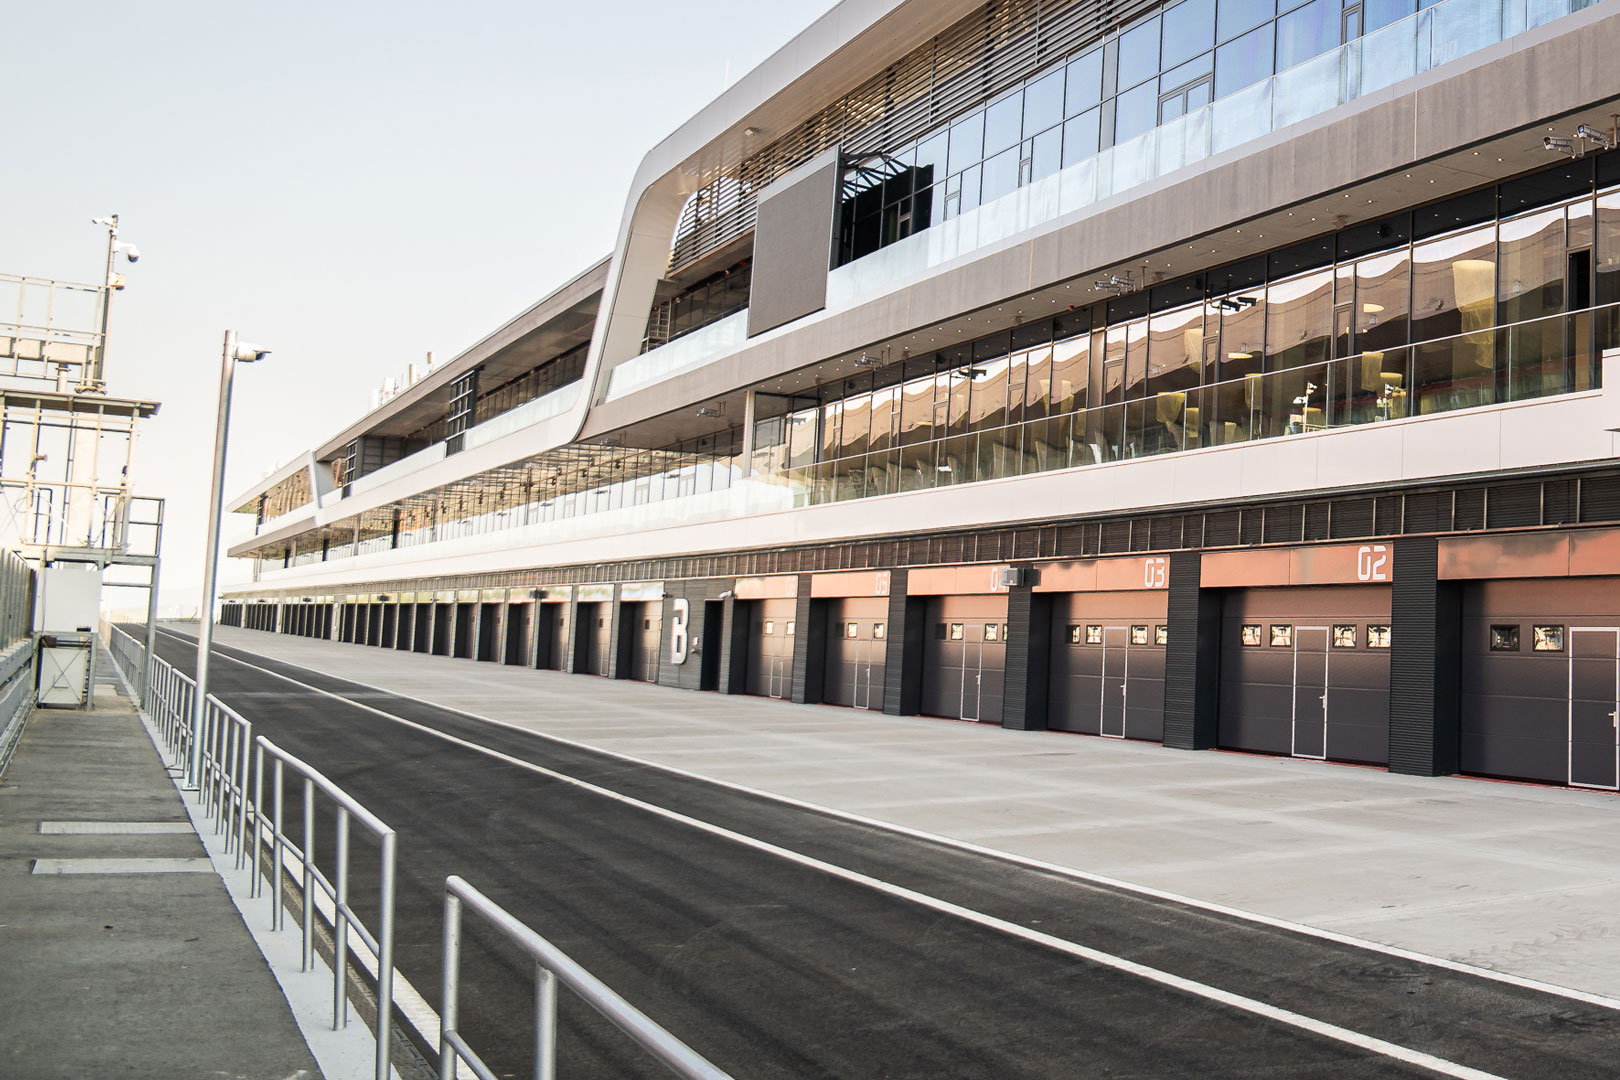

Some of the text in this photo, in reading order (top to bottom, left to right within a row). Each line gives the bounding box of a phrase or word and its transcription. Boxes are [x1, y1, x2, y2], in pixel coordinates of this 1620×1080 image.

[1144, 557, 1165, 588] 03
[1357, 545, 1387, 581] 02
[671, 598, 689, 665] B
